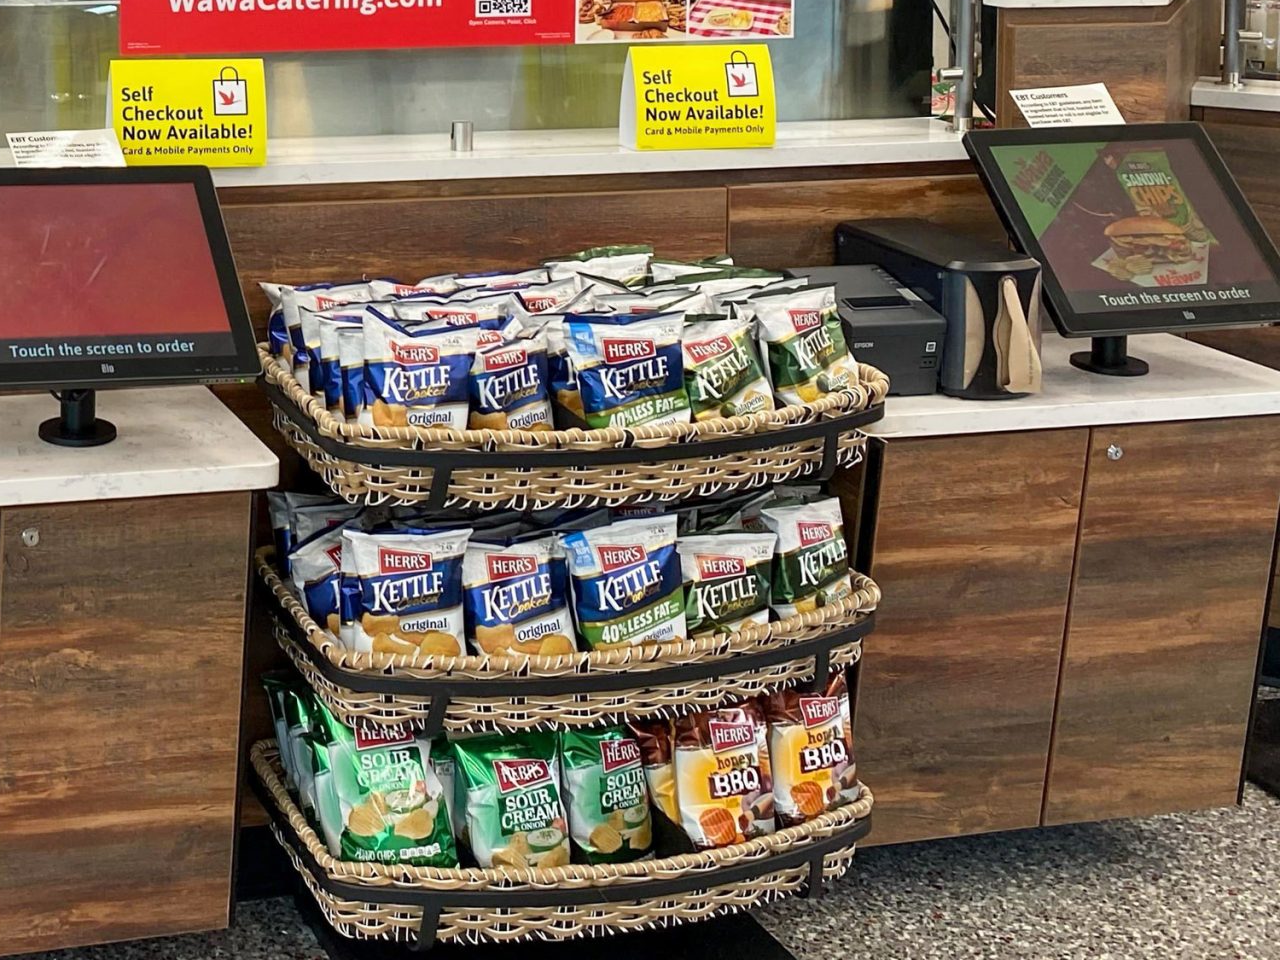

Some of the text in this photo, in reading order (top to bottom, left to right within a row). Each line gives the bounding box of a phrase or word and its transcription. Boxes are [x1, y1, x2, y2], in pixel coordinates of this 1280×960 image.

[643, 70, 671, 84] Self
[122, 86, 153, 102] Self
[645, 88, 718, 103] Checkout
[122, 106, 203, 122] Checkout
[646, 105, 763, 121] Now Available!
[123, 124, 252, 141] Now Available!
[645, 126, 664, 135] Card
[675, 126, 702, 134] Mobile
[705, 126, 743, 134] Payments
[746, 125, 764, 134] Only
[122, 145, 253, 155] Card & Mobile Payments Only
[1099, 288, 1250, 306] Touch the screen to order
[9, 340, 195, 358] Touch the screen to order
[608, 341, 651, 359] HERR'S
[599, 356, 669, 400] KETTLE
[608, 398, 673, 427] 40% LESS FAT
[384, 554, 426, 568] HERR'S
[492, 559, 532, 574] HERR'S
[372, 572, 444, 611] KETTLE
[482, 574, 551, 621] KETTLE
[402, 618, 447, 631] Original
[518, 620, 560, 641] Original
[714, 728, 751, 748] HERR'S
[716, 754, 752, 771] honey
[714, 767, 759, 796] BBQ
[505, 789, 551, 810] SOUR
[501, 802, 560, 829] CREAM
